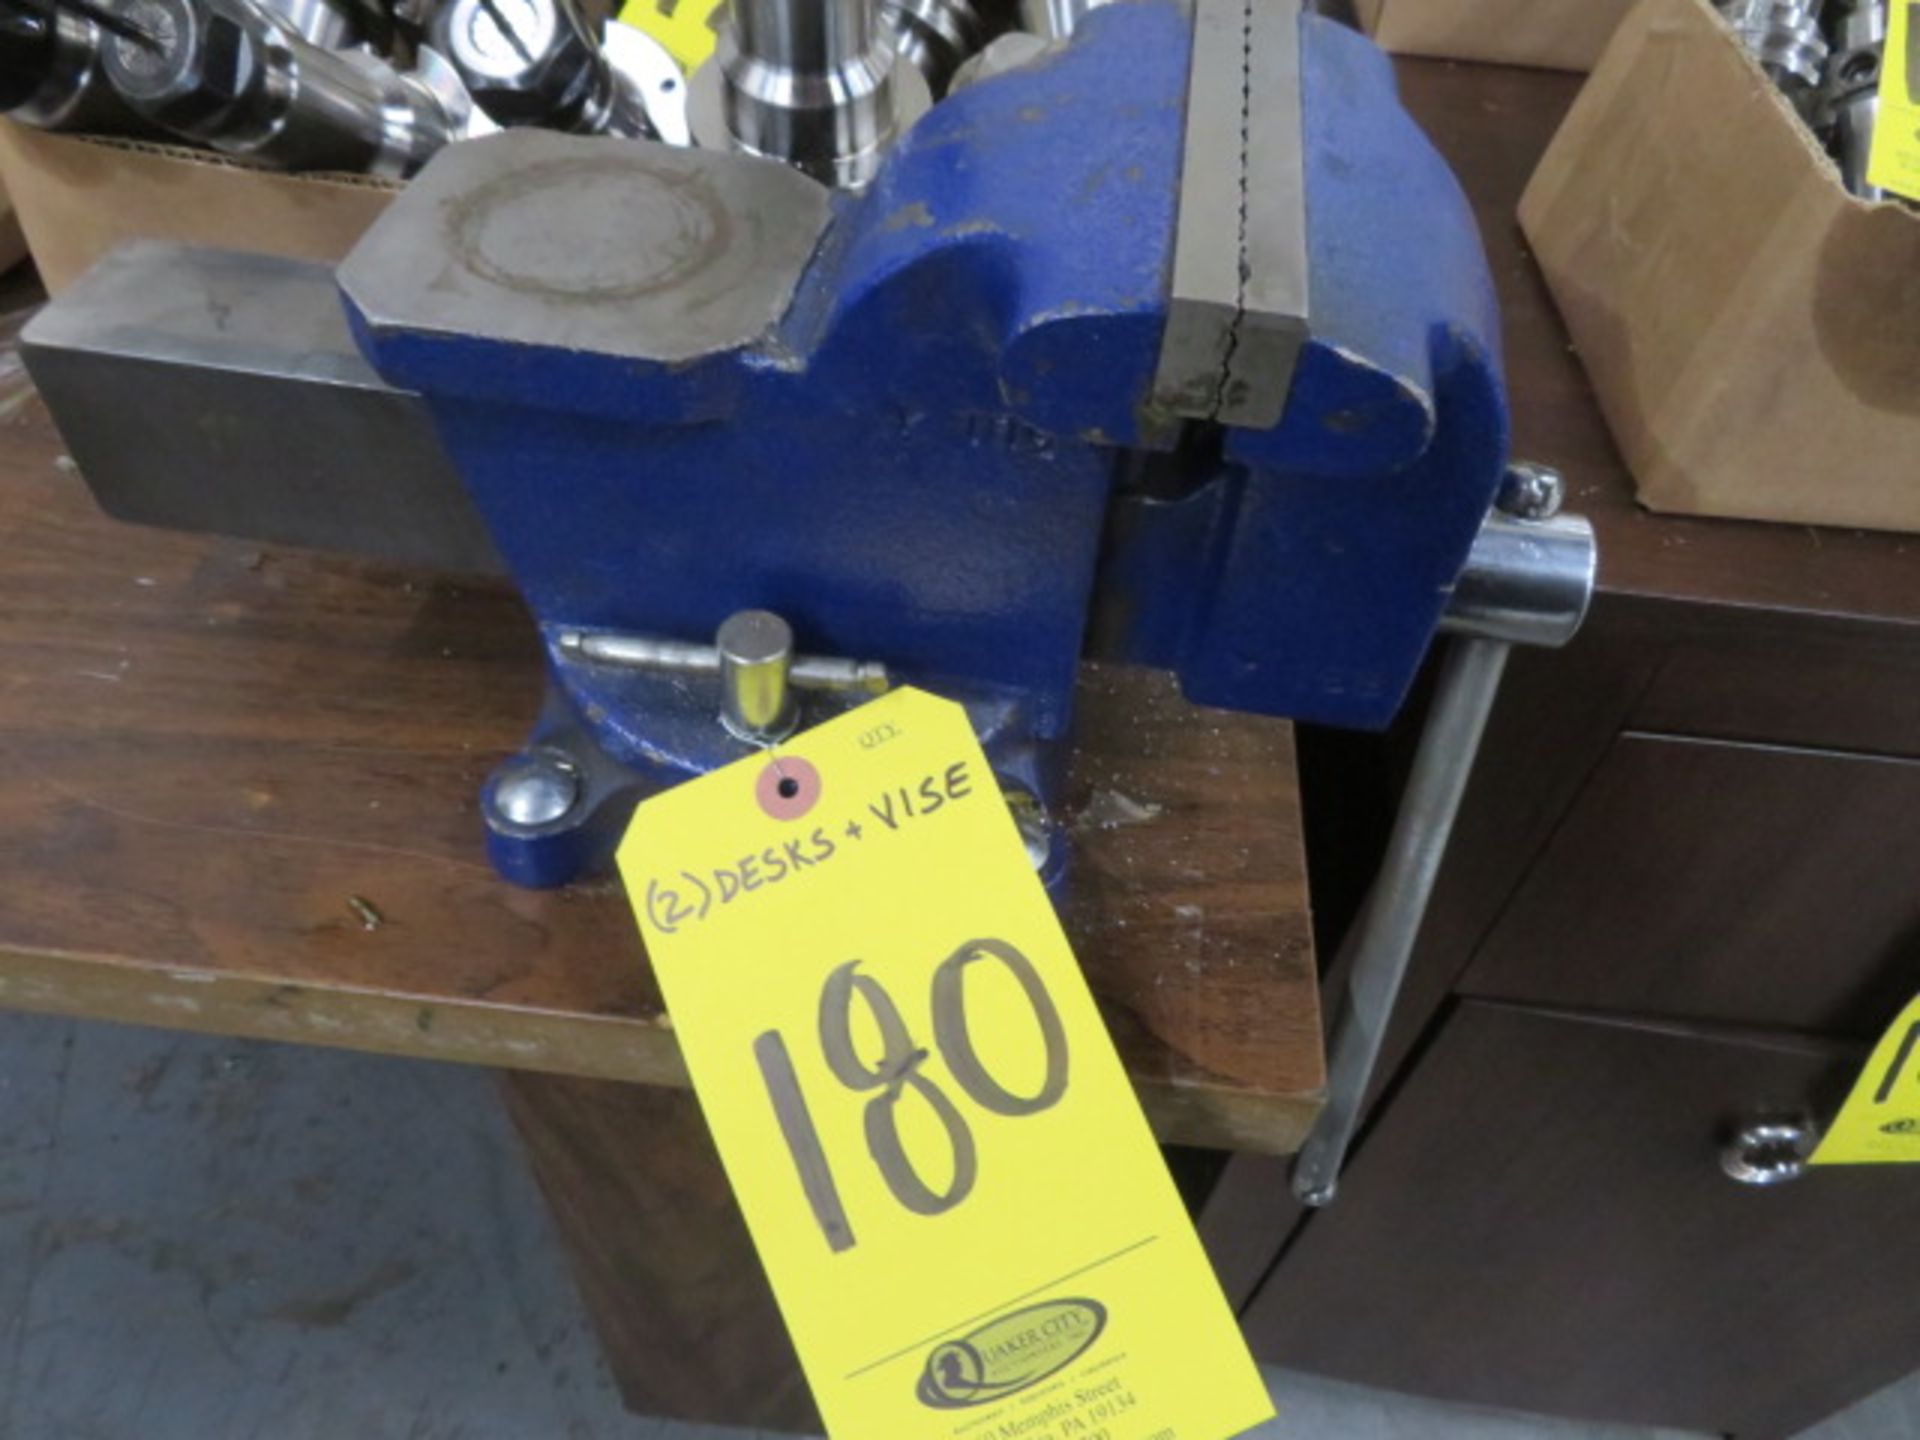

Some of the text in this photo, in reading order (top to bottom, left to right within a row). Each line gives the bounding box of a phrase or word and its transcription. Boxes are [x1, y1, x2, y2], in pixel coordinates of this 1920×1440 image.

[868, 761, 972, 831] VISE
[753, 937, 1069, 1254] 180
[1041, 1309, 1083, 1337] CITY
[998, 1401, 1073, 1438] Memphis
[1073, 1376, 1123, 1405] Street
[1060, 1416, 1087, 1438] PA
